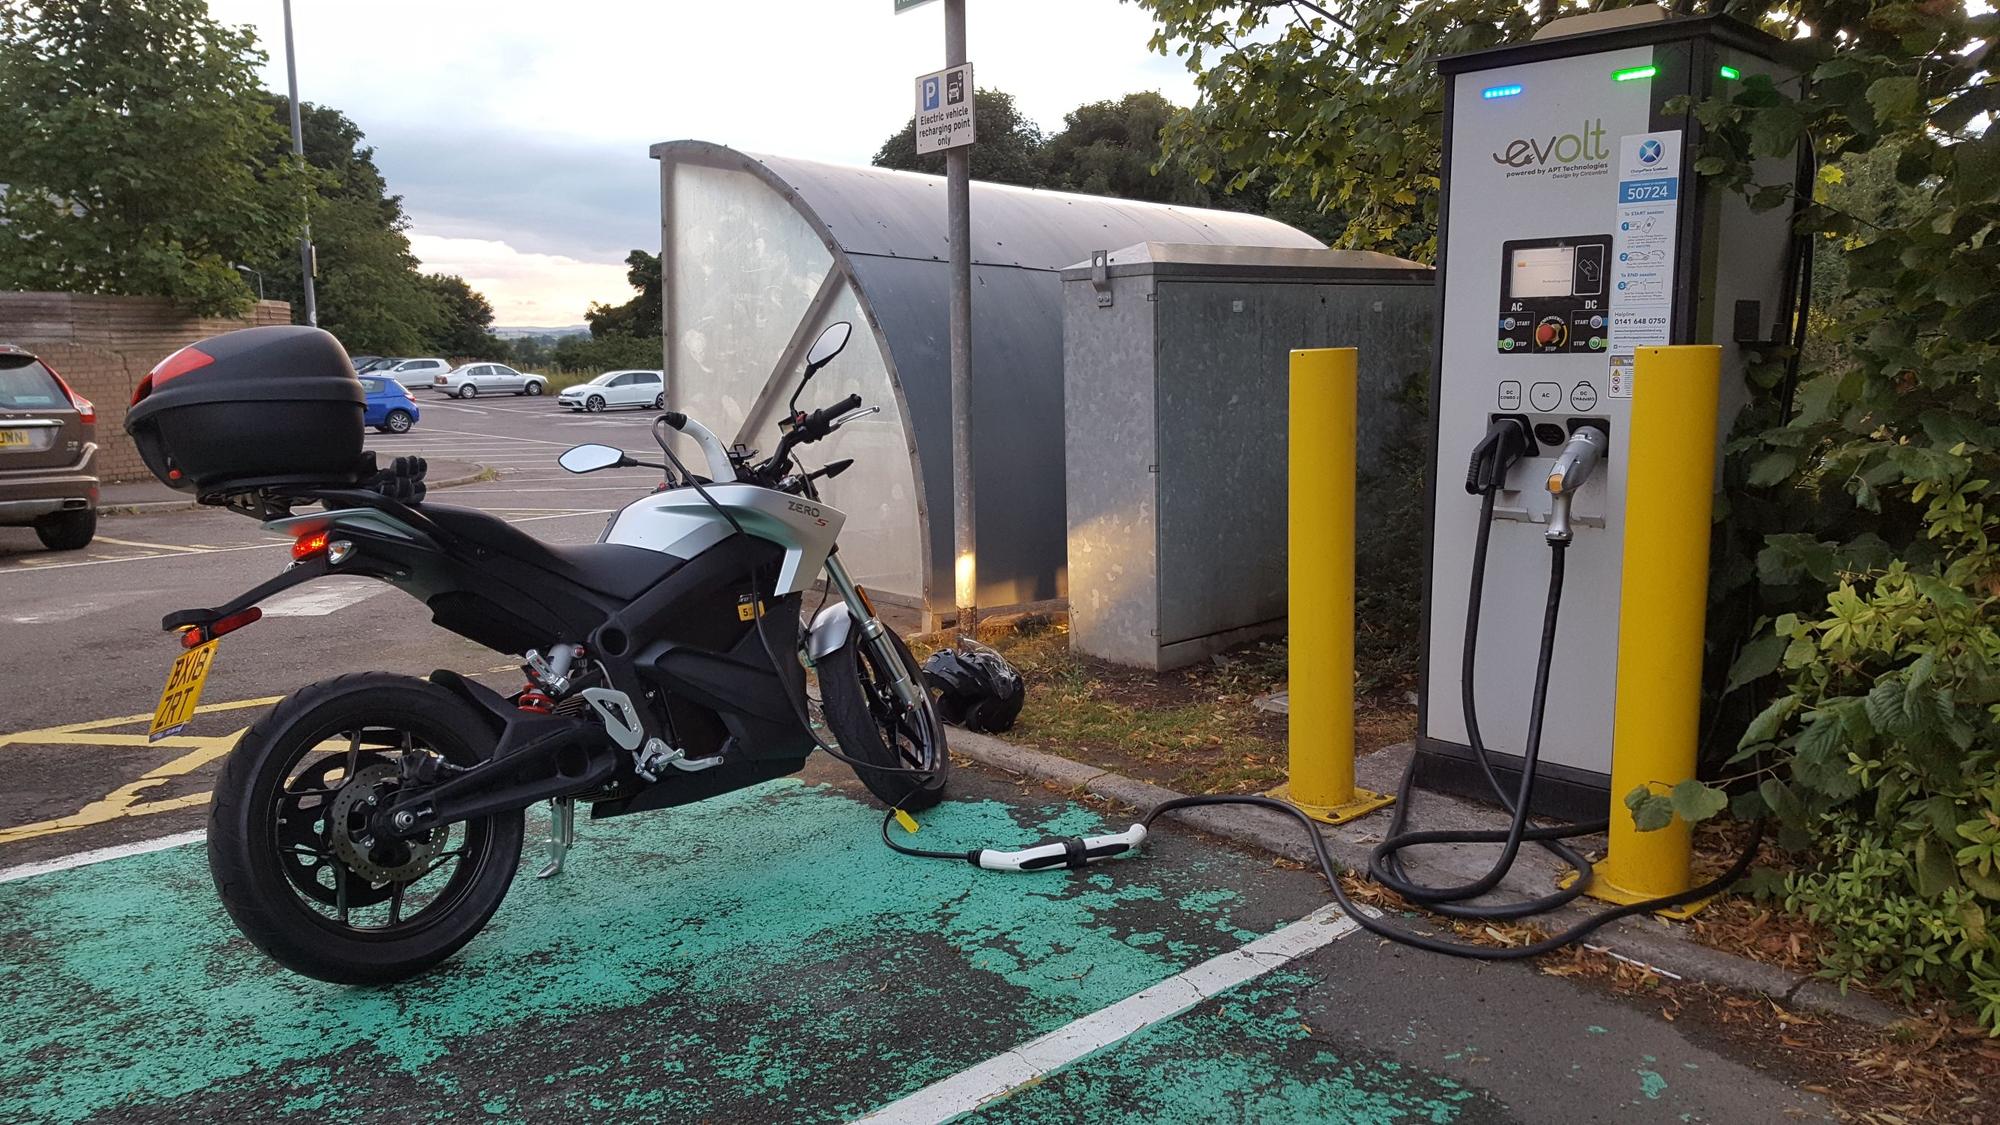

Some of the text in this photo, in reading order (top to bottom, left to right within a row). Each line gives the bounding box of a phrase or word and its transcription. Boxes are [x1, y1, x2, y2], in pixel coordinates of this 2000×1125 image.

[926, 81, 936, 107] P
[920, 105, 969, 126] Electric vehicle
[919, 118, 971, 138] recharging point
[937, 135, 951, 146] only
[1493, 118, 1610, 167] evolt
[1506, 169, 1536, 178] powered
[1563, 162, 1608, 171] Technologies
[1627, 185, 1668, 200] 50724
[1511, 300, 1598, 311] AC DC
[787, 500, 820, 518] ZERO
[815, 518, 829, 527] S
[167, 647, 209, 691] BX18
[155, 686, 195, 729] ZRT
